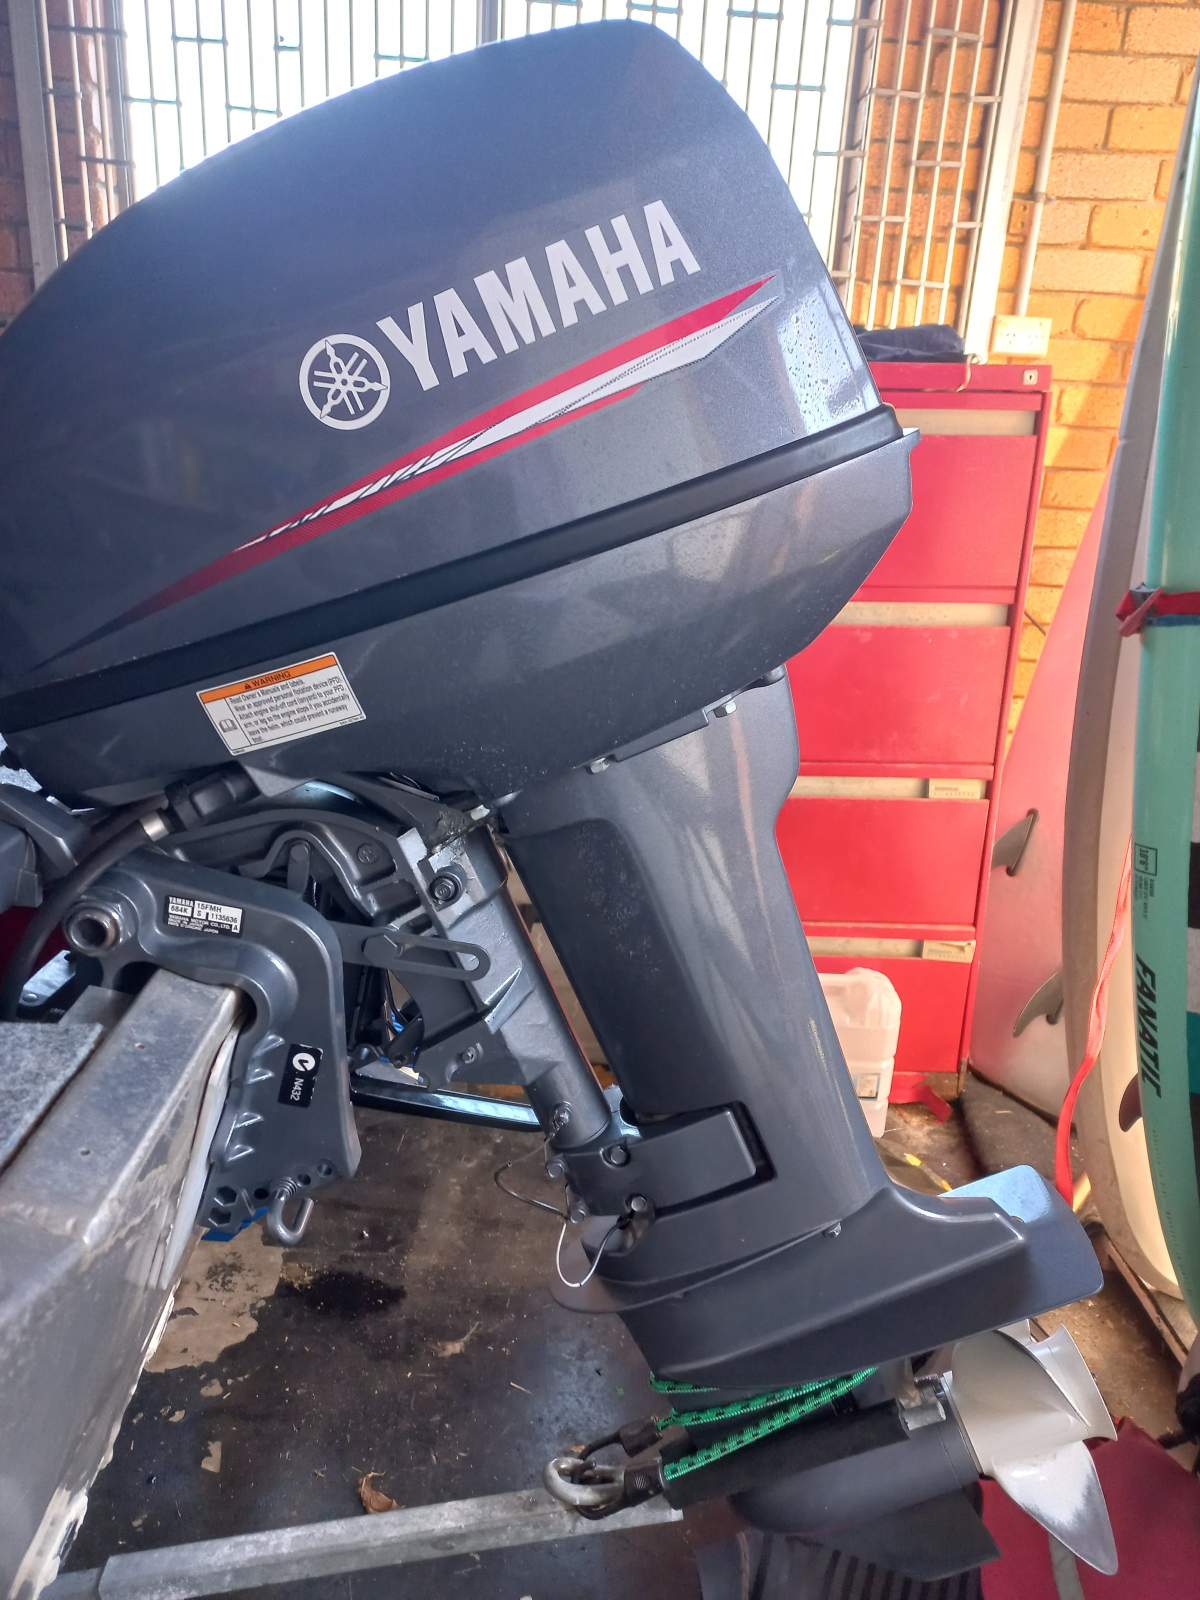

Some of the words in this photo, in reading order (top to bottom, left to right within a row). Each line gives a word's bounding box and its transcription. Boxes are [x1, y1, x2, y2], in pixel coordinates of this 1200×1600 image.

[376, 200, 701, 391] YAMAHA
[252, 671, 291, 687] WARNING
[239, 711, 254, 720] Attach
[253, 707, 270, 717] engine
[285, 699, 298, 707] cord
[322, 688, 335, 697] your
[252, 697, 276, 709] approved
[273, 691, 295, 703] personal
[312, 681, 329, 690] device
[280, 709, 298, 720] engine
[295, 706, 310, 715] stops
[313, 702, 324, 710] you
[322, 694, 351, 708] accidentally
[280, 719, 294, 728] which
[293, 715, 307, 724] could
[306, 710, 326, 722] prevent
[327, 704, 349, 715] runaway
[169, 897, 194, 907] YAMAHA
[197, 903, 222, 913] 15FMH
[190, 918, 209, 926] MOTOR
[1136, 953, 1161, 1098] FANATIC
[290, 1077, 304, 1101] N432
